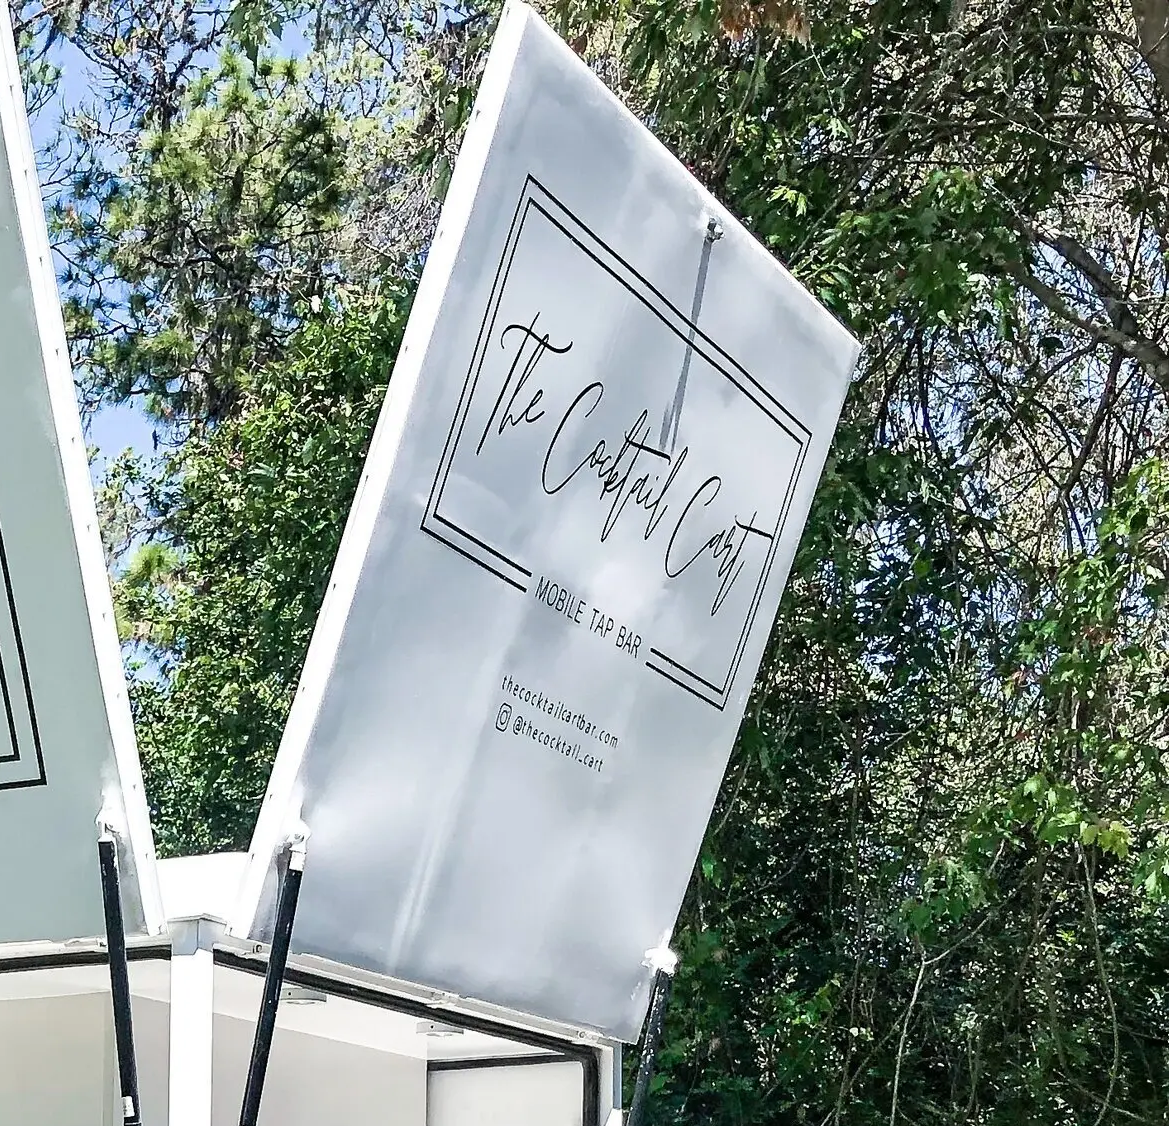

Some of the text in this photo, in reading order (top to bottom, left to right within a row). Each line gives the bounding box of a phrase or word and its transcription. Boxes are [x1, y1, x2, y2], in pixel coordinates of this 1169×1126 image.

[476, 311, 774, 617] The Cocktail Cart
[534, 575, 643, 659] MOBILE TAP BAR
[501, 674, 619, 749] thecocktailcartbar.com
[512, 715, 604, 773] @thecocktail_cart
